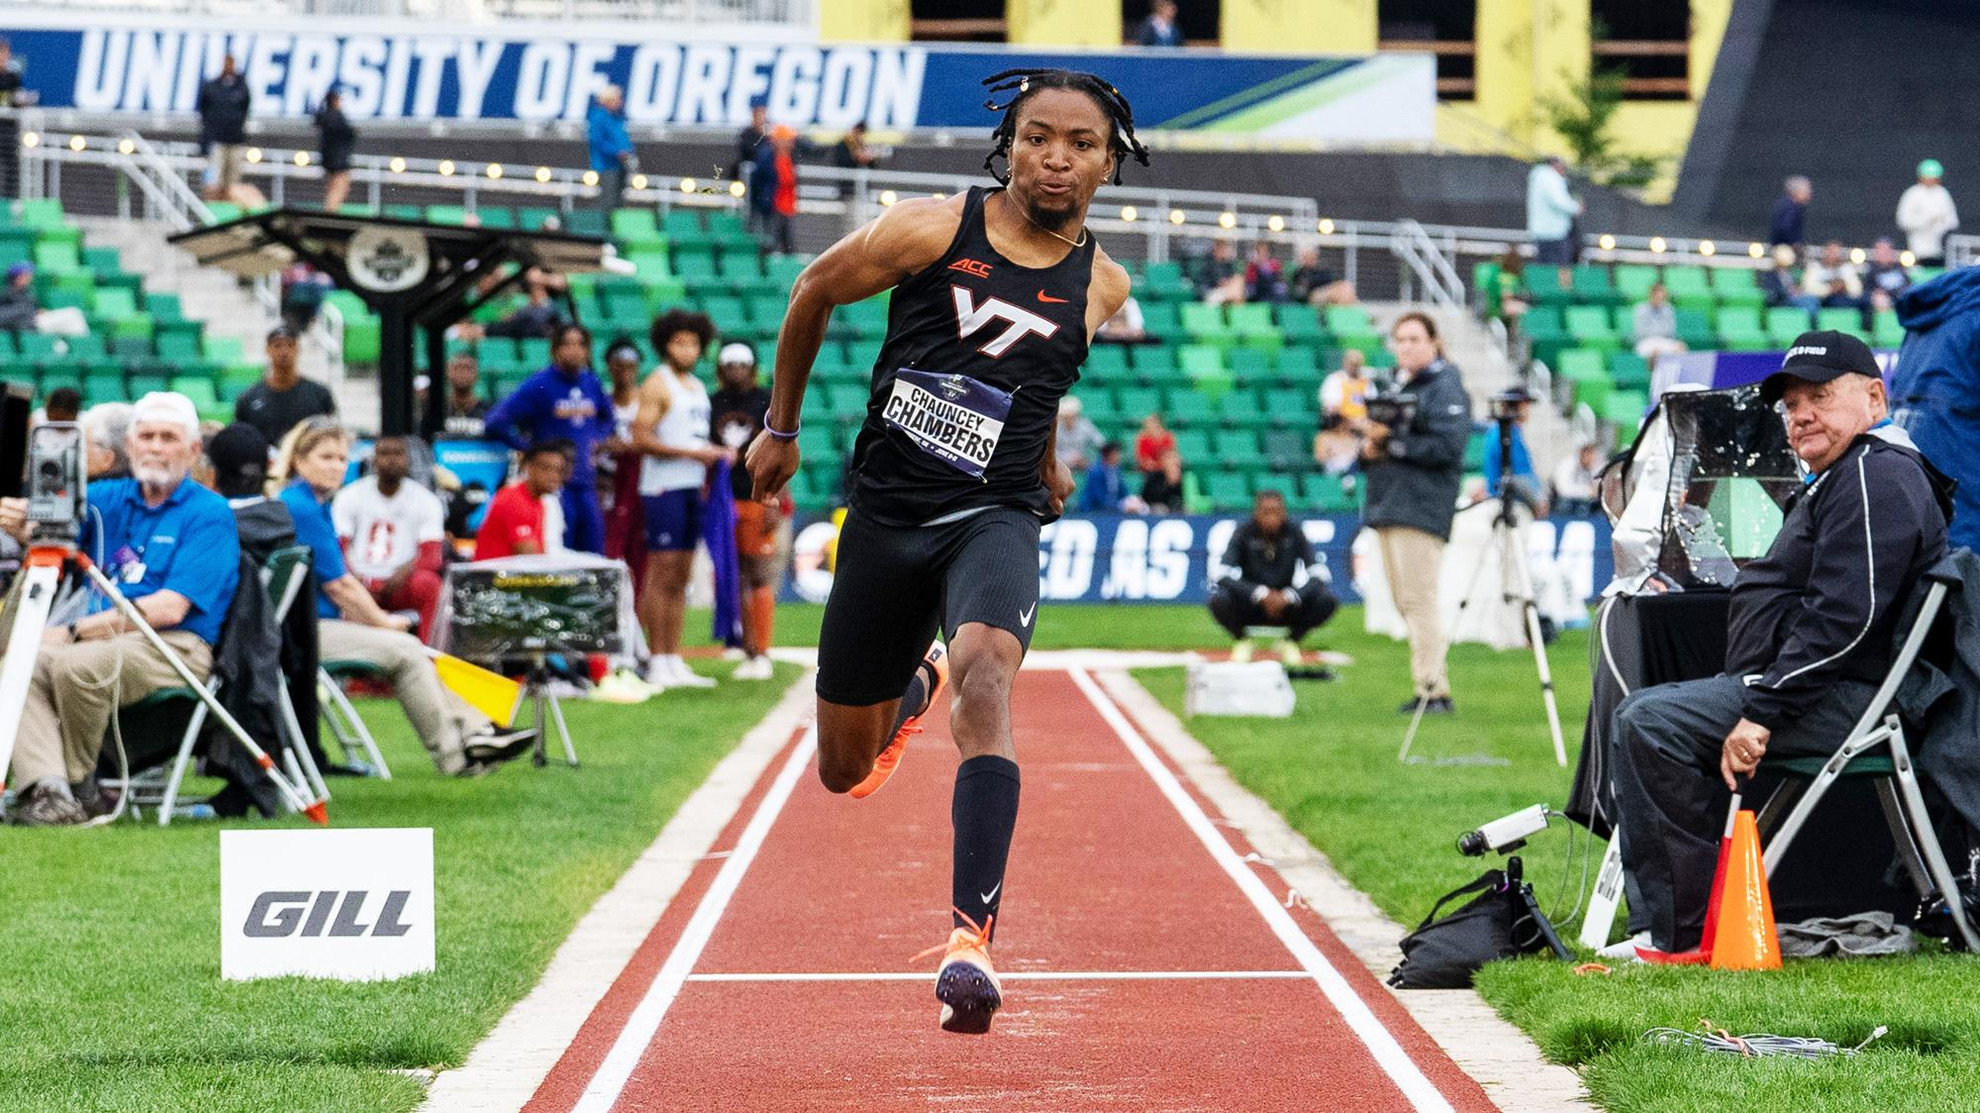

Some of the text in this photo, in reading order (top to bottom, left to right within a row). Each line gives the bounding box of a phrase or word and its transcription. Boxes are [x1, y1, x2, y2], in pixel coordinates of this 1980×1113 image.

[74, 30, 927, 128] UNIVERSITY OF OREGON
[947, 258, 994, 279] ACC
[951, 284, 1061, 359] VT
[886, 395, 995, 462] CHAMBERS
[911, 388, 985, 431] CHAUNCEY
[1101, 519, 1194, 600] AS
[243, 890, 414, 938] GILL
